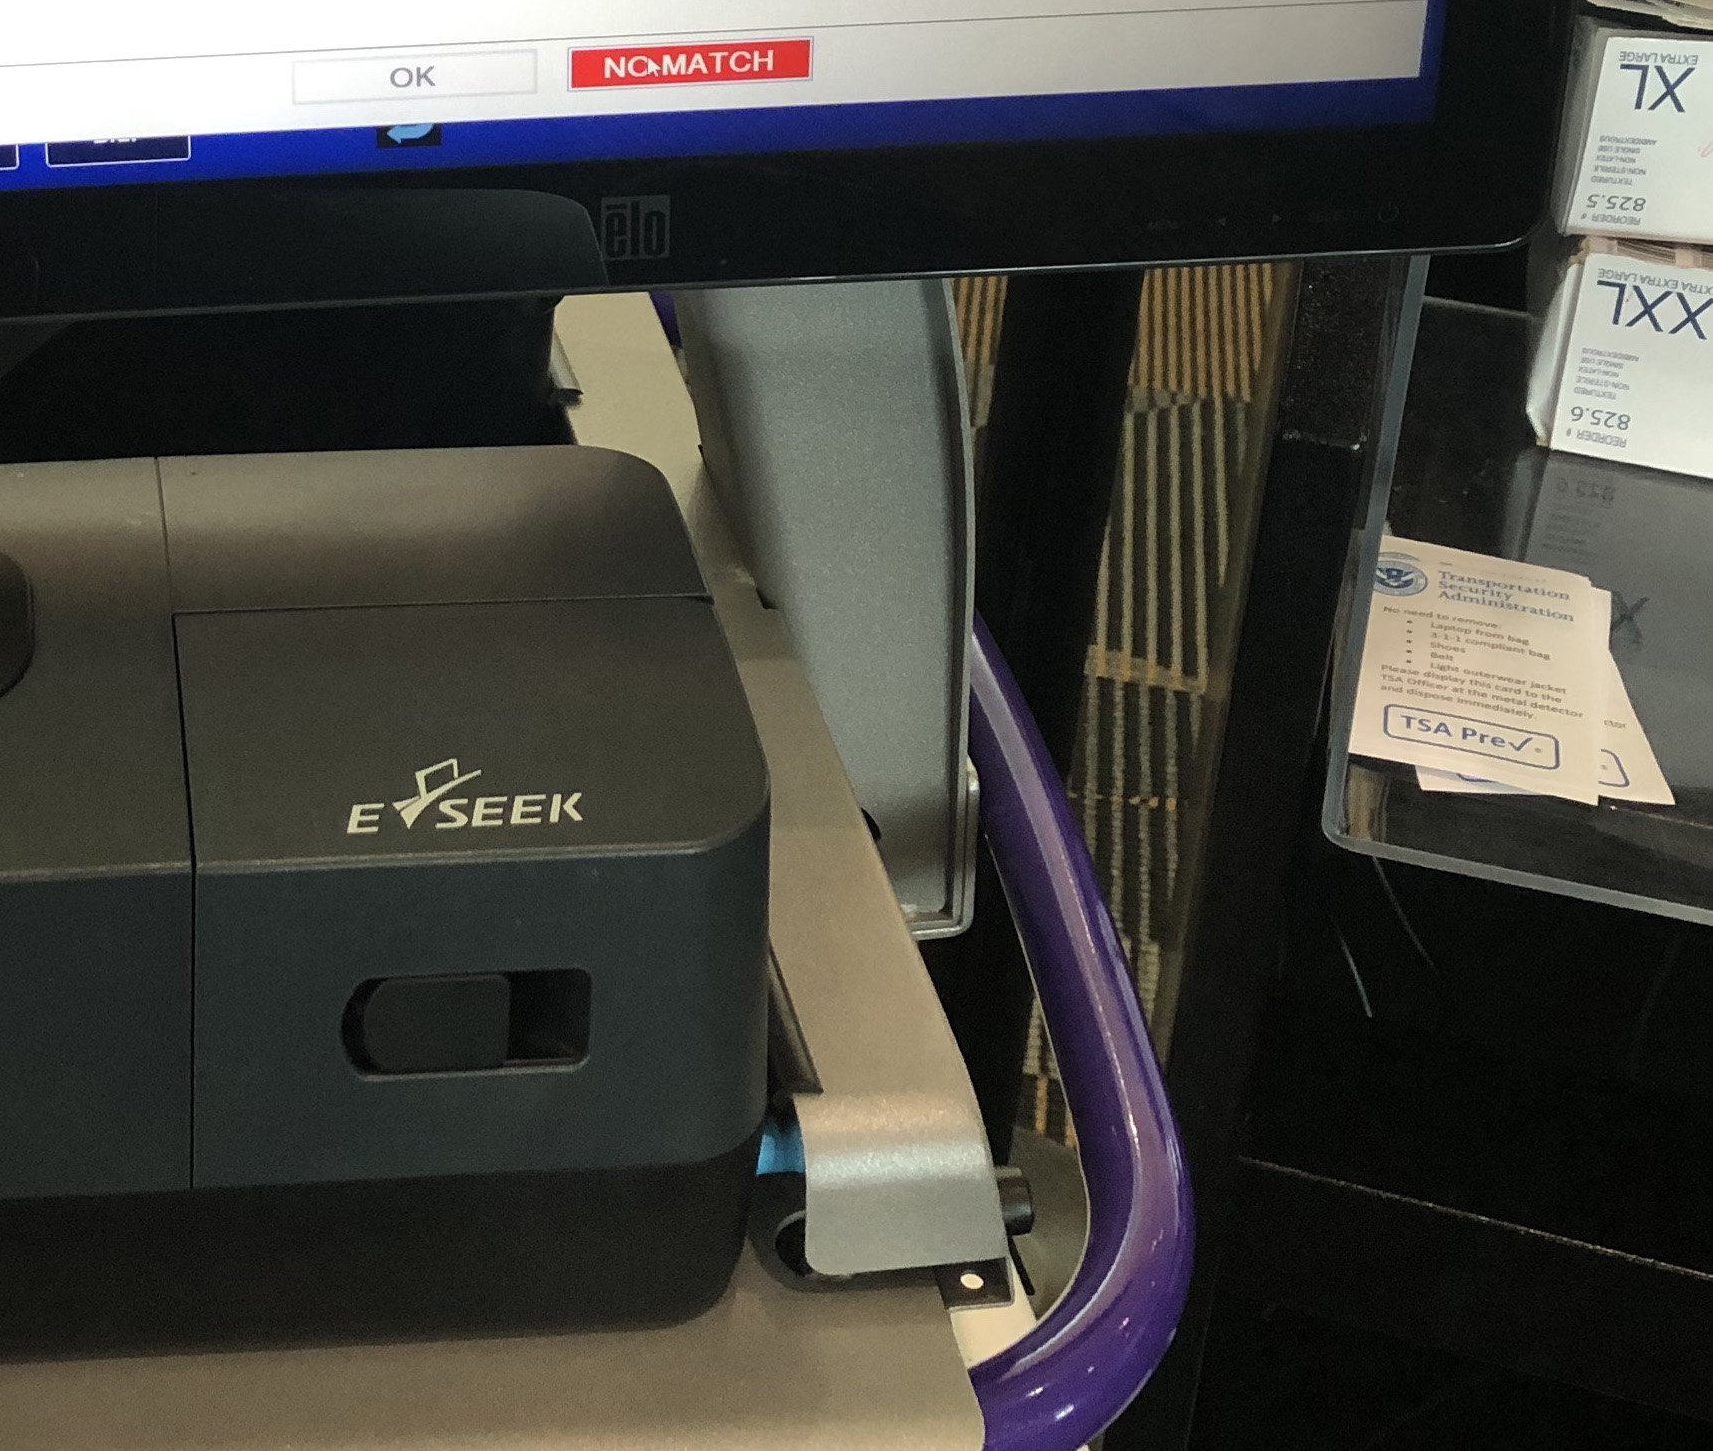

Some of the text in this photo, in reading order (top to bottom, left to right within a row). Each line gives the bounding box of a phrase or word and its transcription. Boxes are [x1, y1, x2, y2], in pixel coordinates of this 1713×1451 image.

[1618, 50, 1699, 66] EXTRA LARGE
[388, 64, 437, 90] OK
[1619, 63, 1697, 113] XL
[1586, 194, 1647, 212] 825.5
[1597, 267, 1638, 282] LARGE
[1596, 279, 1713, 341] XXL
[1570, 405, 1632, 431] 825.6
[1437, 569, 1571, 601] Transportation
[1438, 579, 1515, 601] Security
[1437, 590, 1576, 623] Administration
[1399, 714, 1454, 738] TSA
